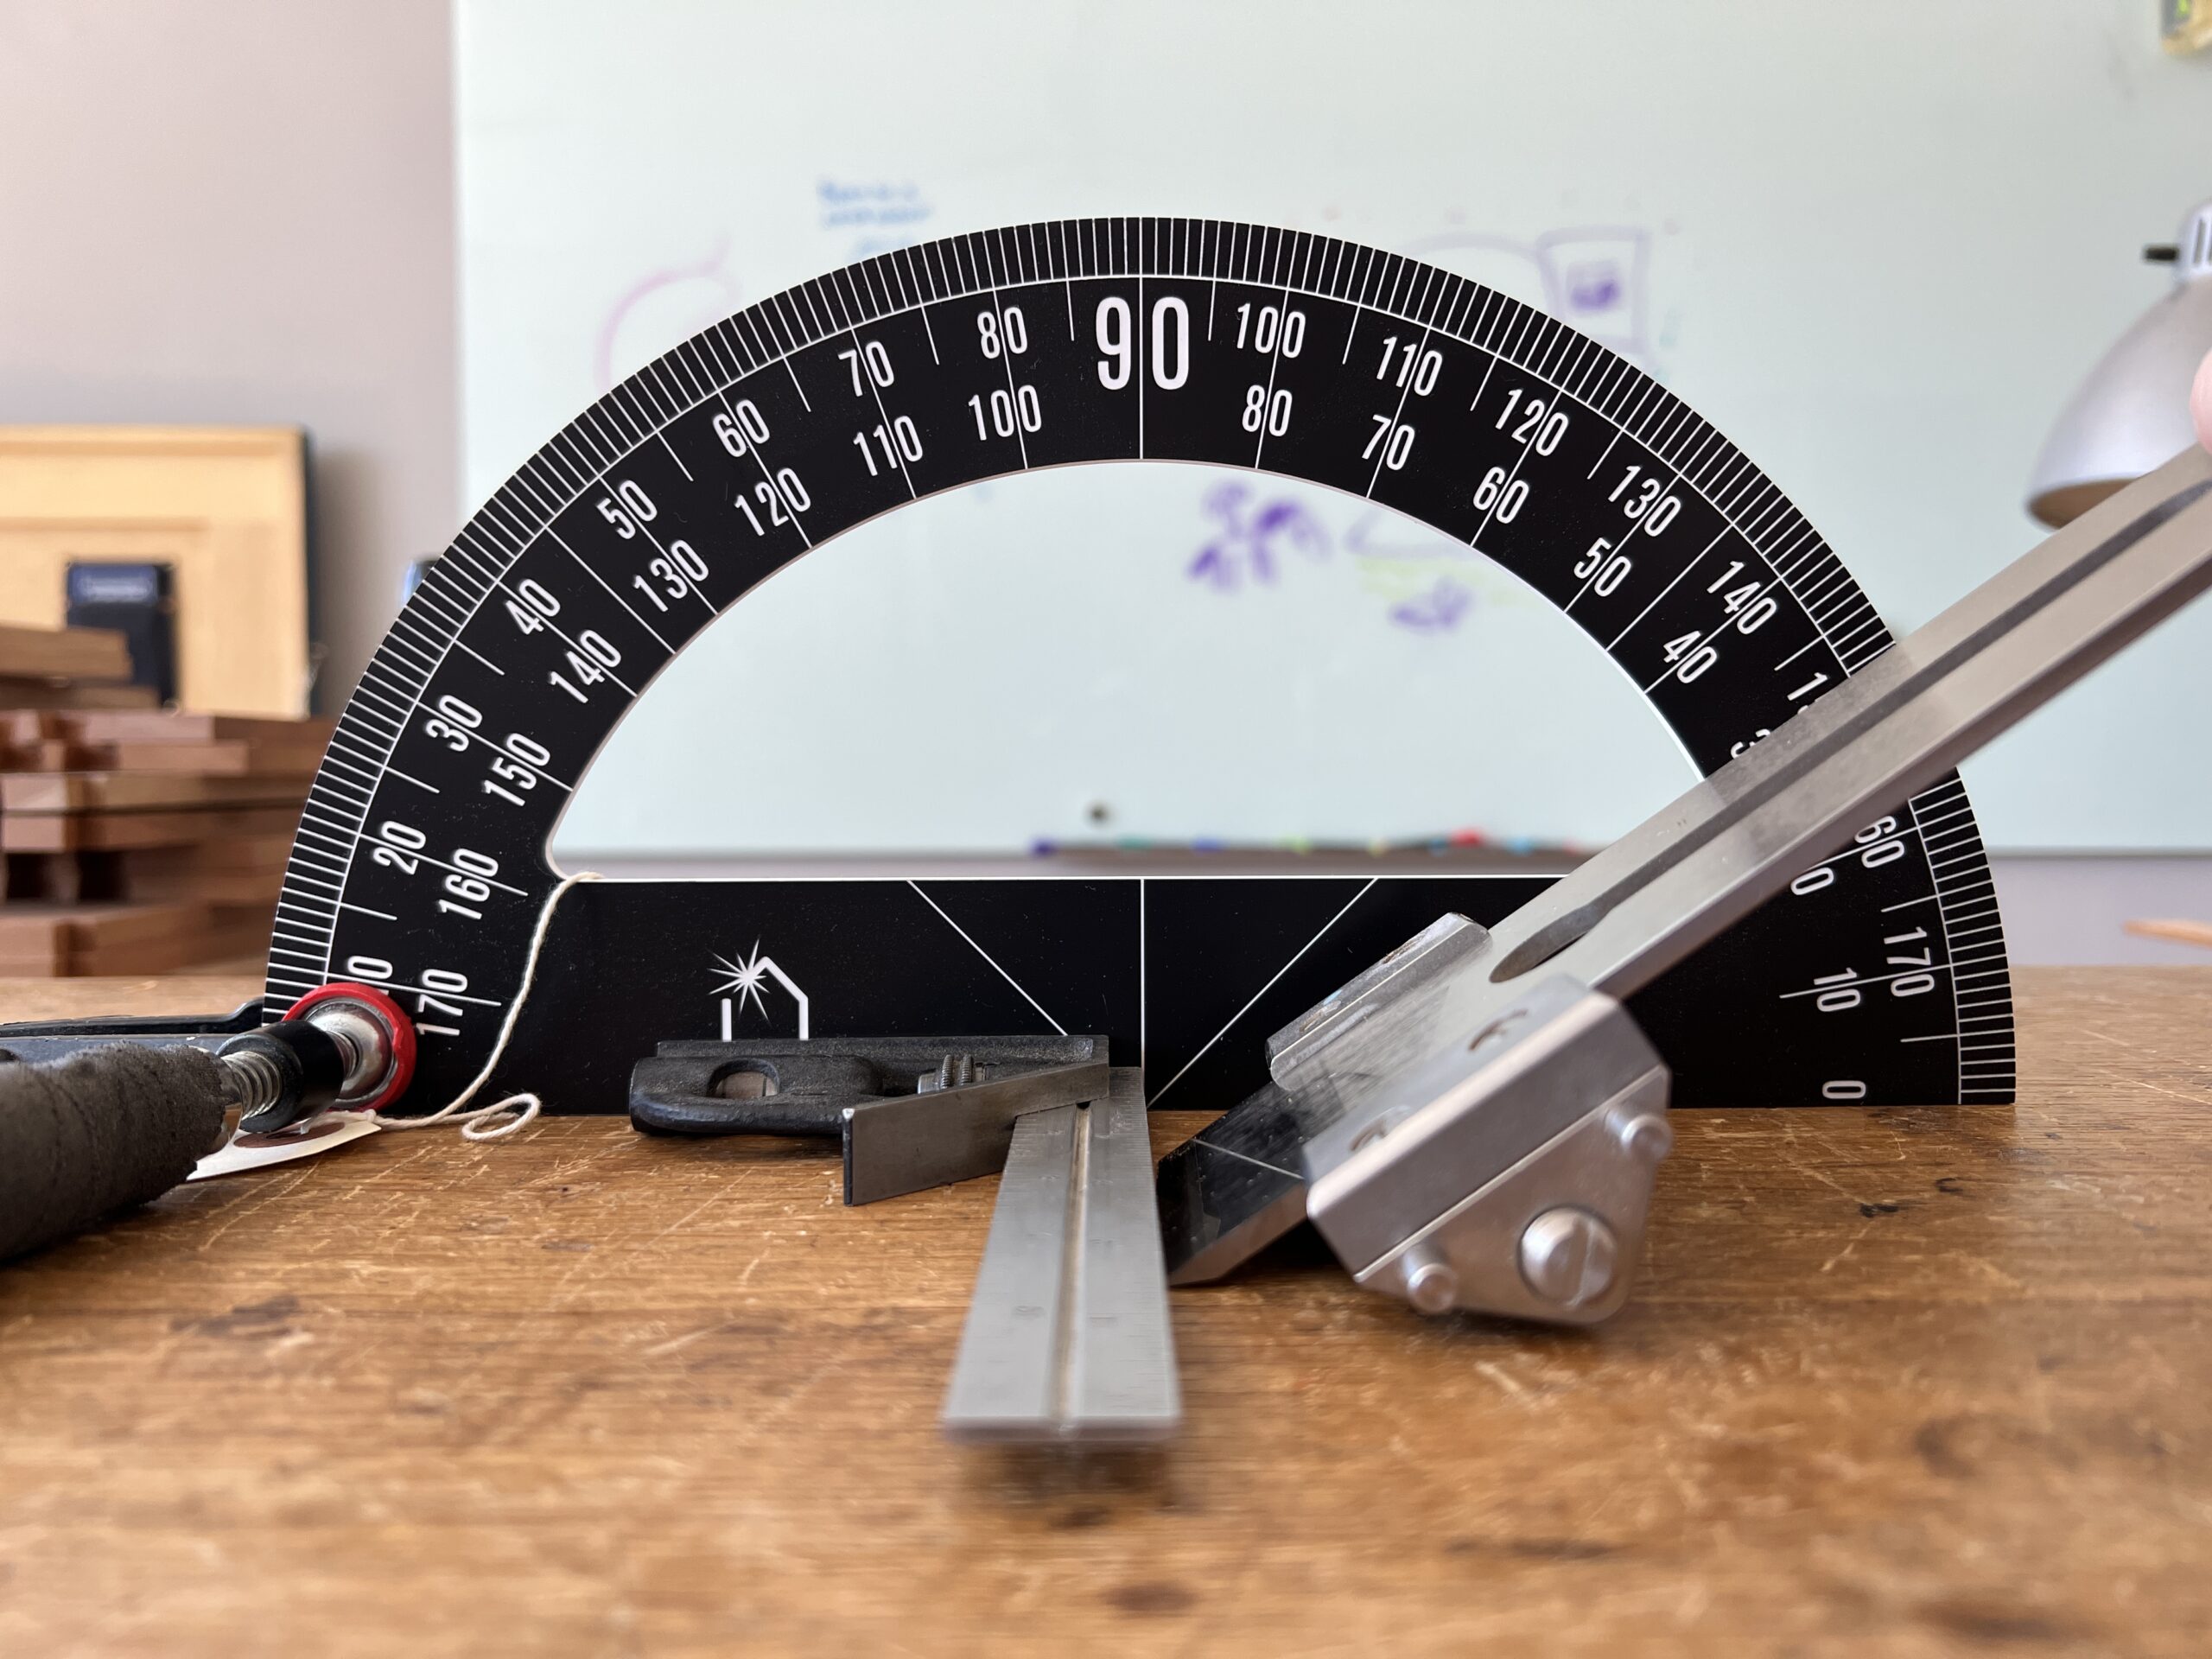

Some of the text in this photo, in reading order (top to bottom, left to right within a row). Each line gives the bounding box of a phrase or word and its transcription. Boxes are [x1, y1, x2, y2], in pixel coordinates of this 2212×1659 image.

[976, 307, 1028, 359] 80
[1095, 296, 1190, 391] 90
[1236, 302, 1306, 359] 100
[838, 340, 894, 397] 70
[1376, 336, 1444, 397] 110
[711, 399, 770, 458] 60
[968, 385, 1042, 441] 100
[1242, 385, 1293, 437] 80
[1496, 389, 1569, 456] 120
[853, 415, 924, 477] 110
[1362, 413, 1415, 471] 70
[596, 480, 658, 540] 50
[734, 467, 812, 537] 120
[1473, 467, 1529, 524] 60
[1608, 465, 1681, 537] 130
[632, 540, 709, 613] 130
[1573, 537, 1632, 597] 50
[505, 578, 562, 635] 40
[1707, 560, 1777, 635] 140
[548, 629, 622, 703] 140
[1663, 630, 1718, 684] 40
[425, 694, 483, 753] 30
[481, 733, 551, 807] 150
[372, 820, 427, 875] 20
[1854, 814, 1905, 868] 60
[436, 848, 499, 920] 160
[347, 956, 393, 995] 0
[1814, 967, 1861, 1012] 10
[1884, 925, 1935, 997] 170
[416, 969, 468, 1036] 170
[1821, 1079, 1866, 1101] 0
